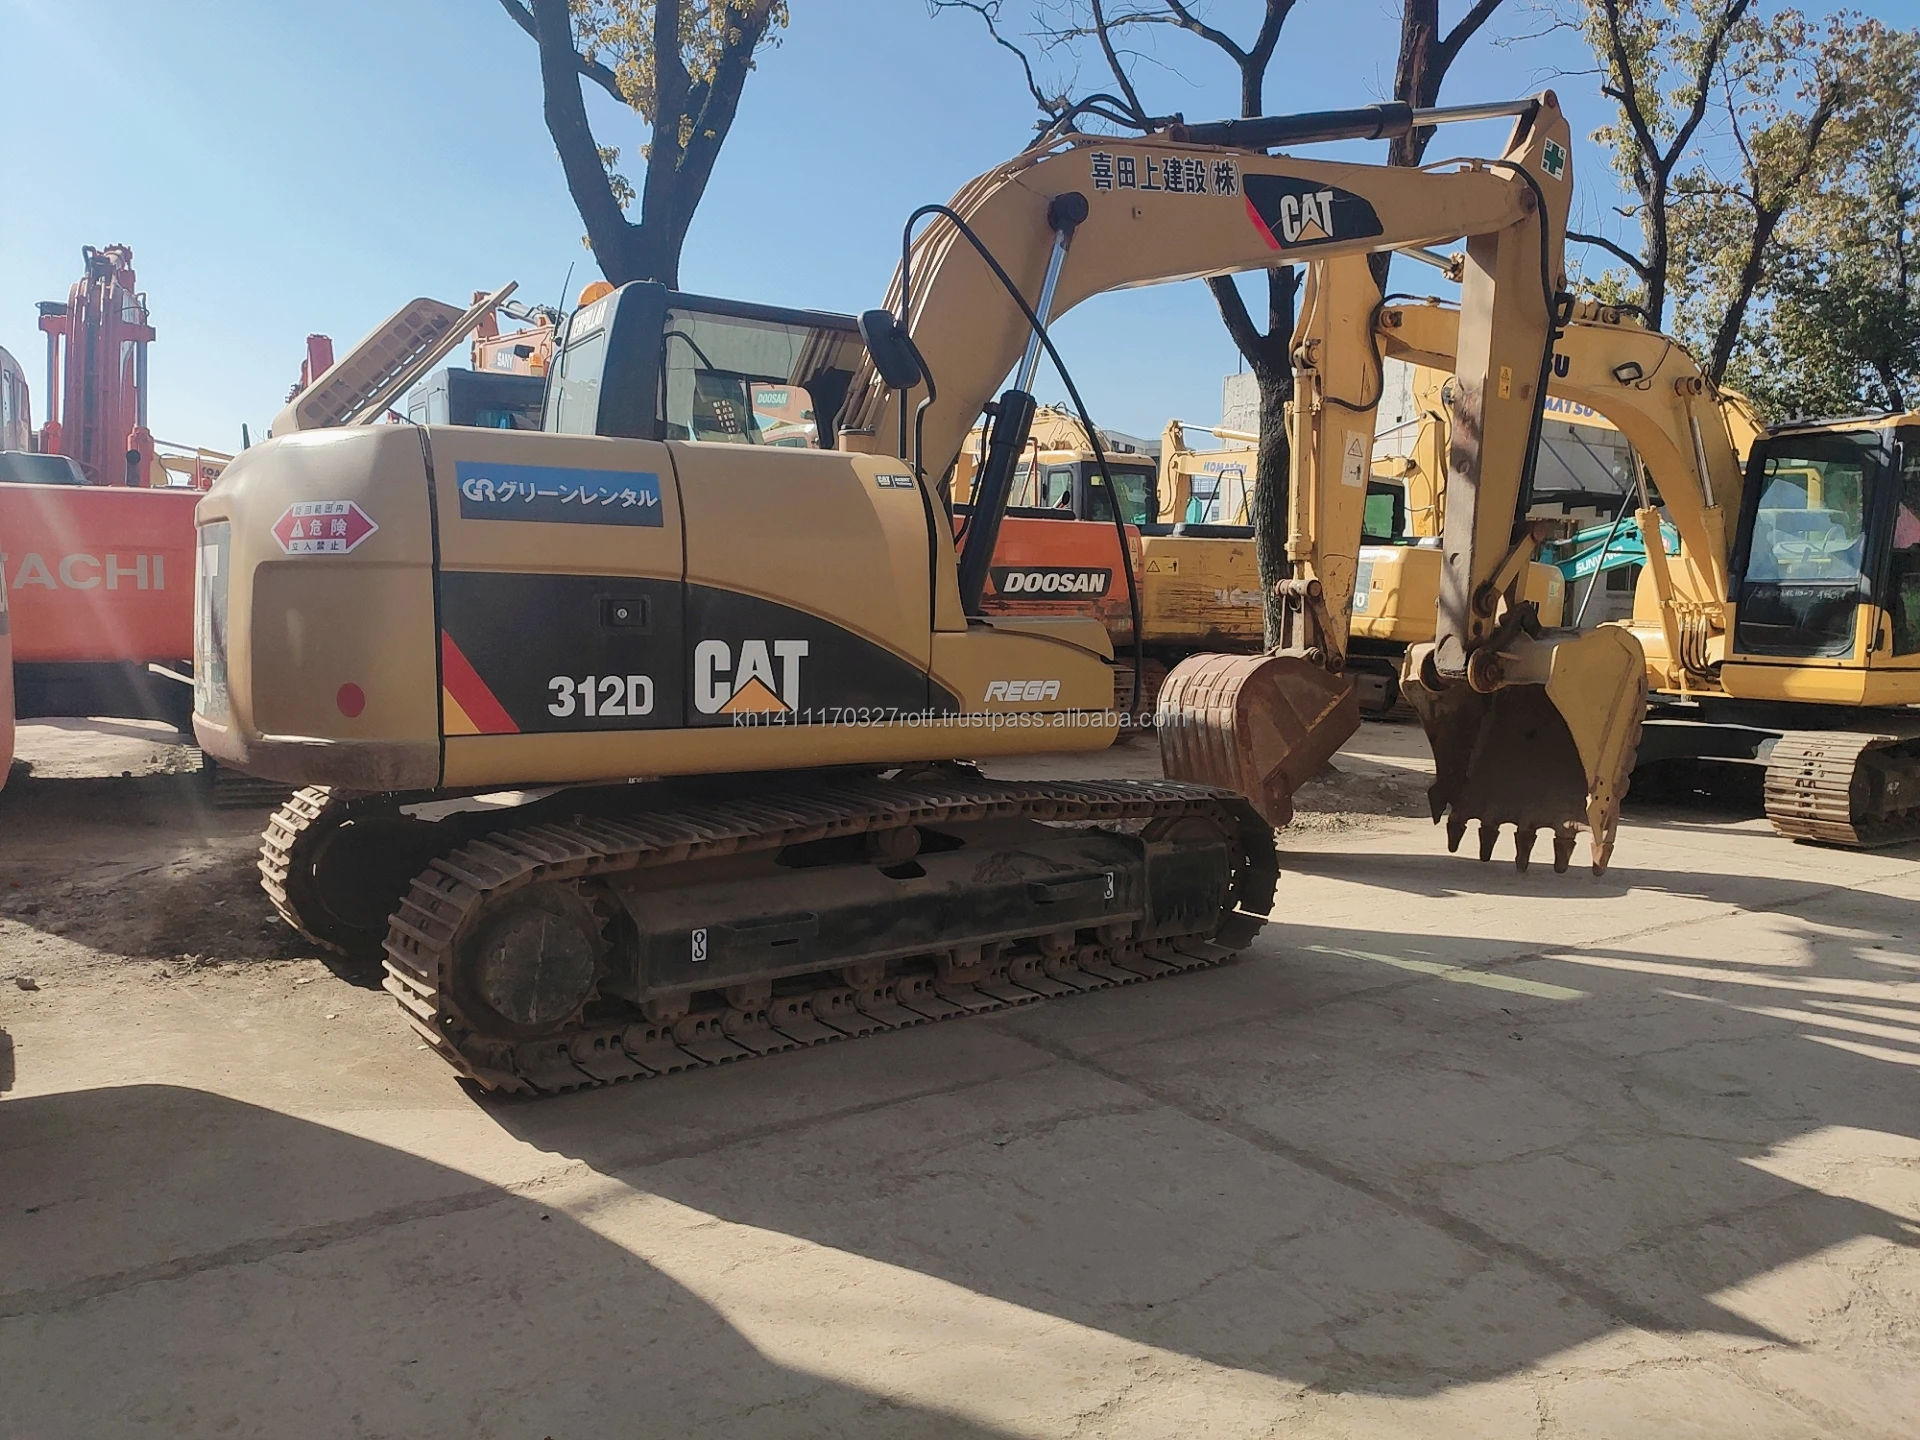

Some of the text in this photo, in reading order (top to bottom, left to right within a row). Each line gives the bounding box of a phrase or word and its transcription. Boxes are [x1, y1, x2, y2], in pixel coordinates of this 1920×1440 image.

[1090, 151, 1240, 197] 喜田上建設(株)
[1280, 191, 1334, 243] CAT
[496, 351, 514, 369] SANY
[757, 393, 788, 404] DOOSAN
[308, 518, 347, 537] 危険
[292, 541, 340, 551] 立入禁止
[1003, 572, 1106, 594] DOOSAN
[694, 639, 809, 714] CAT
[548, 675, 654, 717] 312D
[983, 680, 1061, 702] REGA
